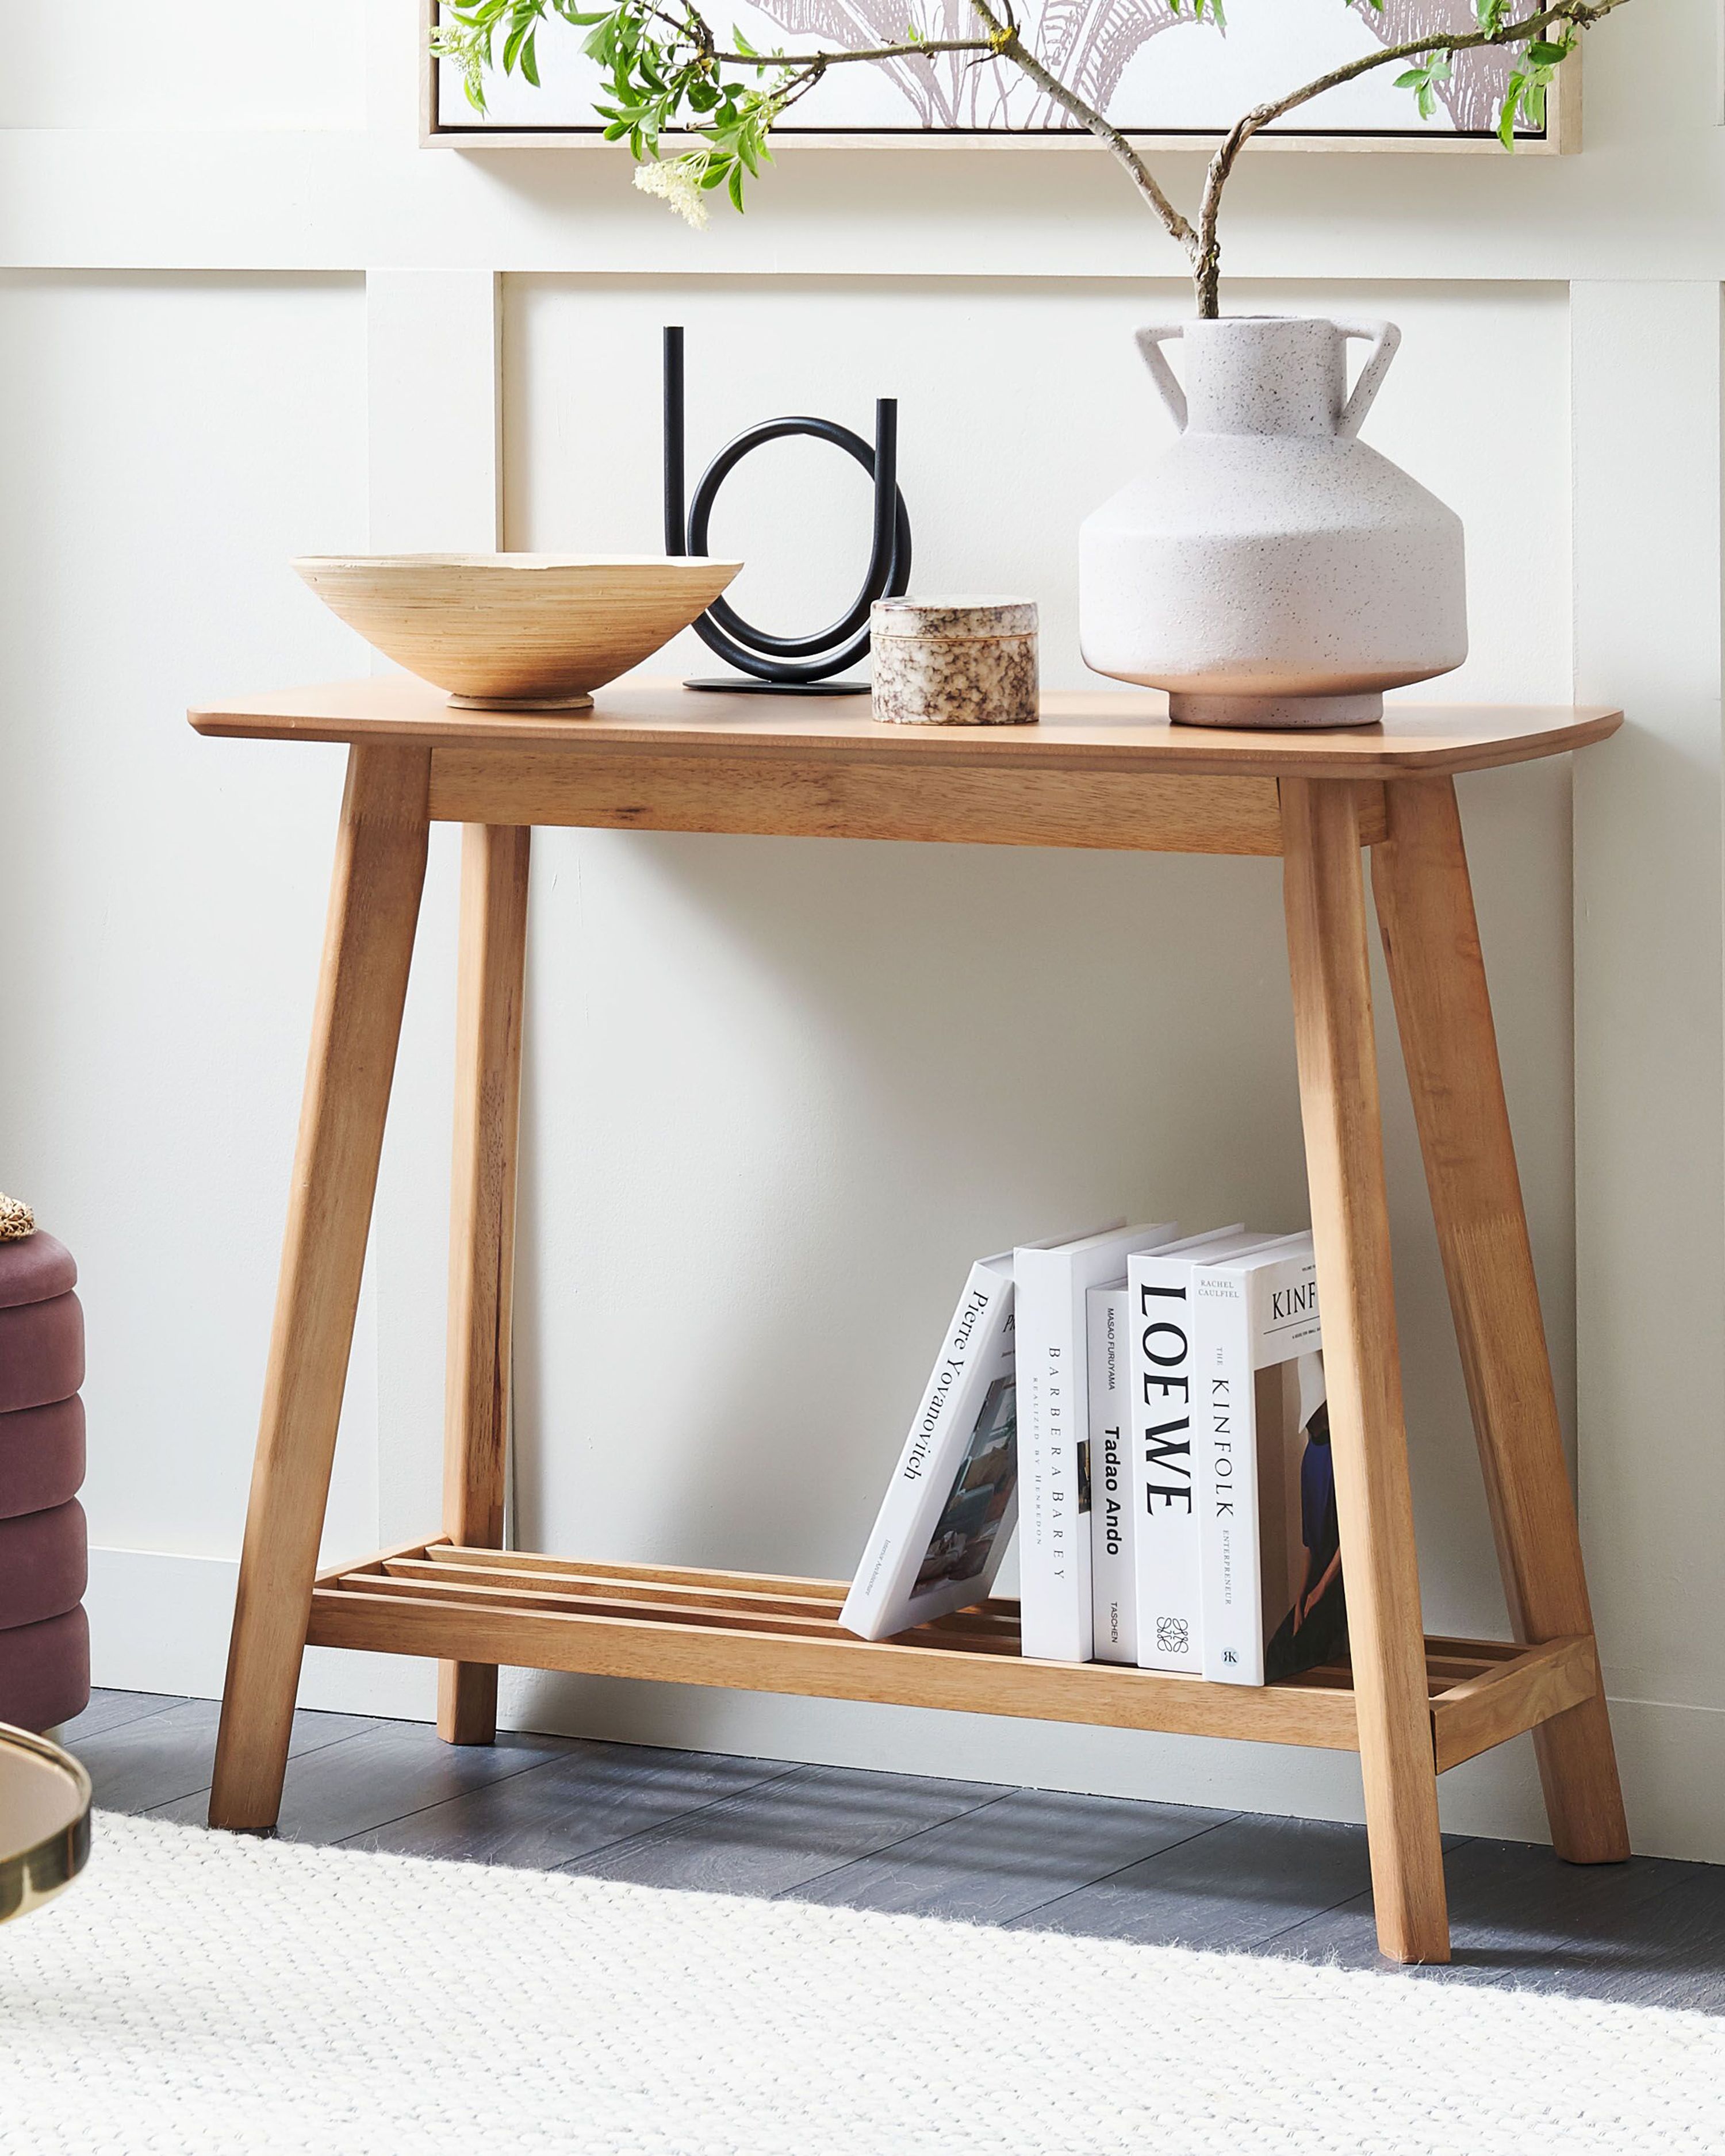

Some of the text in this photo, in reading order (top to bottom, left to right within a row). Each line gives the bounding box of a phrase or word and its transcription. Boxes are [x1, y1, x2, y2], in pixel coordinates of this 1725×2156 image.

[1198, 1289, 1240, 1298] CAULFIEL
[1201, 1280, 1235, 1288] RACHEL
[904, 1290, 989, 1480] Pierre Yovanovitch
[1107, 1341, 1116, 1390] FURUYAMA
[1141, 1283, 1192, 1516] LOEWE
[1035, 1450, 1040, 1464] BY
[1105, 1426, 1122, 1556] Tadao Ando
[1212, 1379, 1234, 1518] KINFOLK
[1223, 1529, 1232, 1605] ENTERPRENEUR
[1052, 1492, 1064, 1579] BAREY
